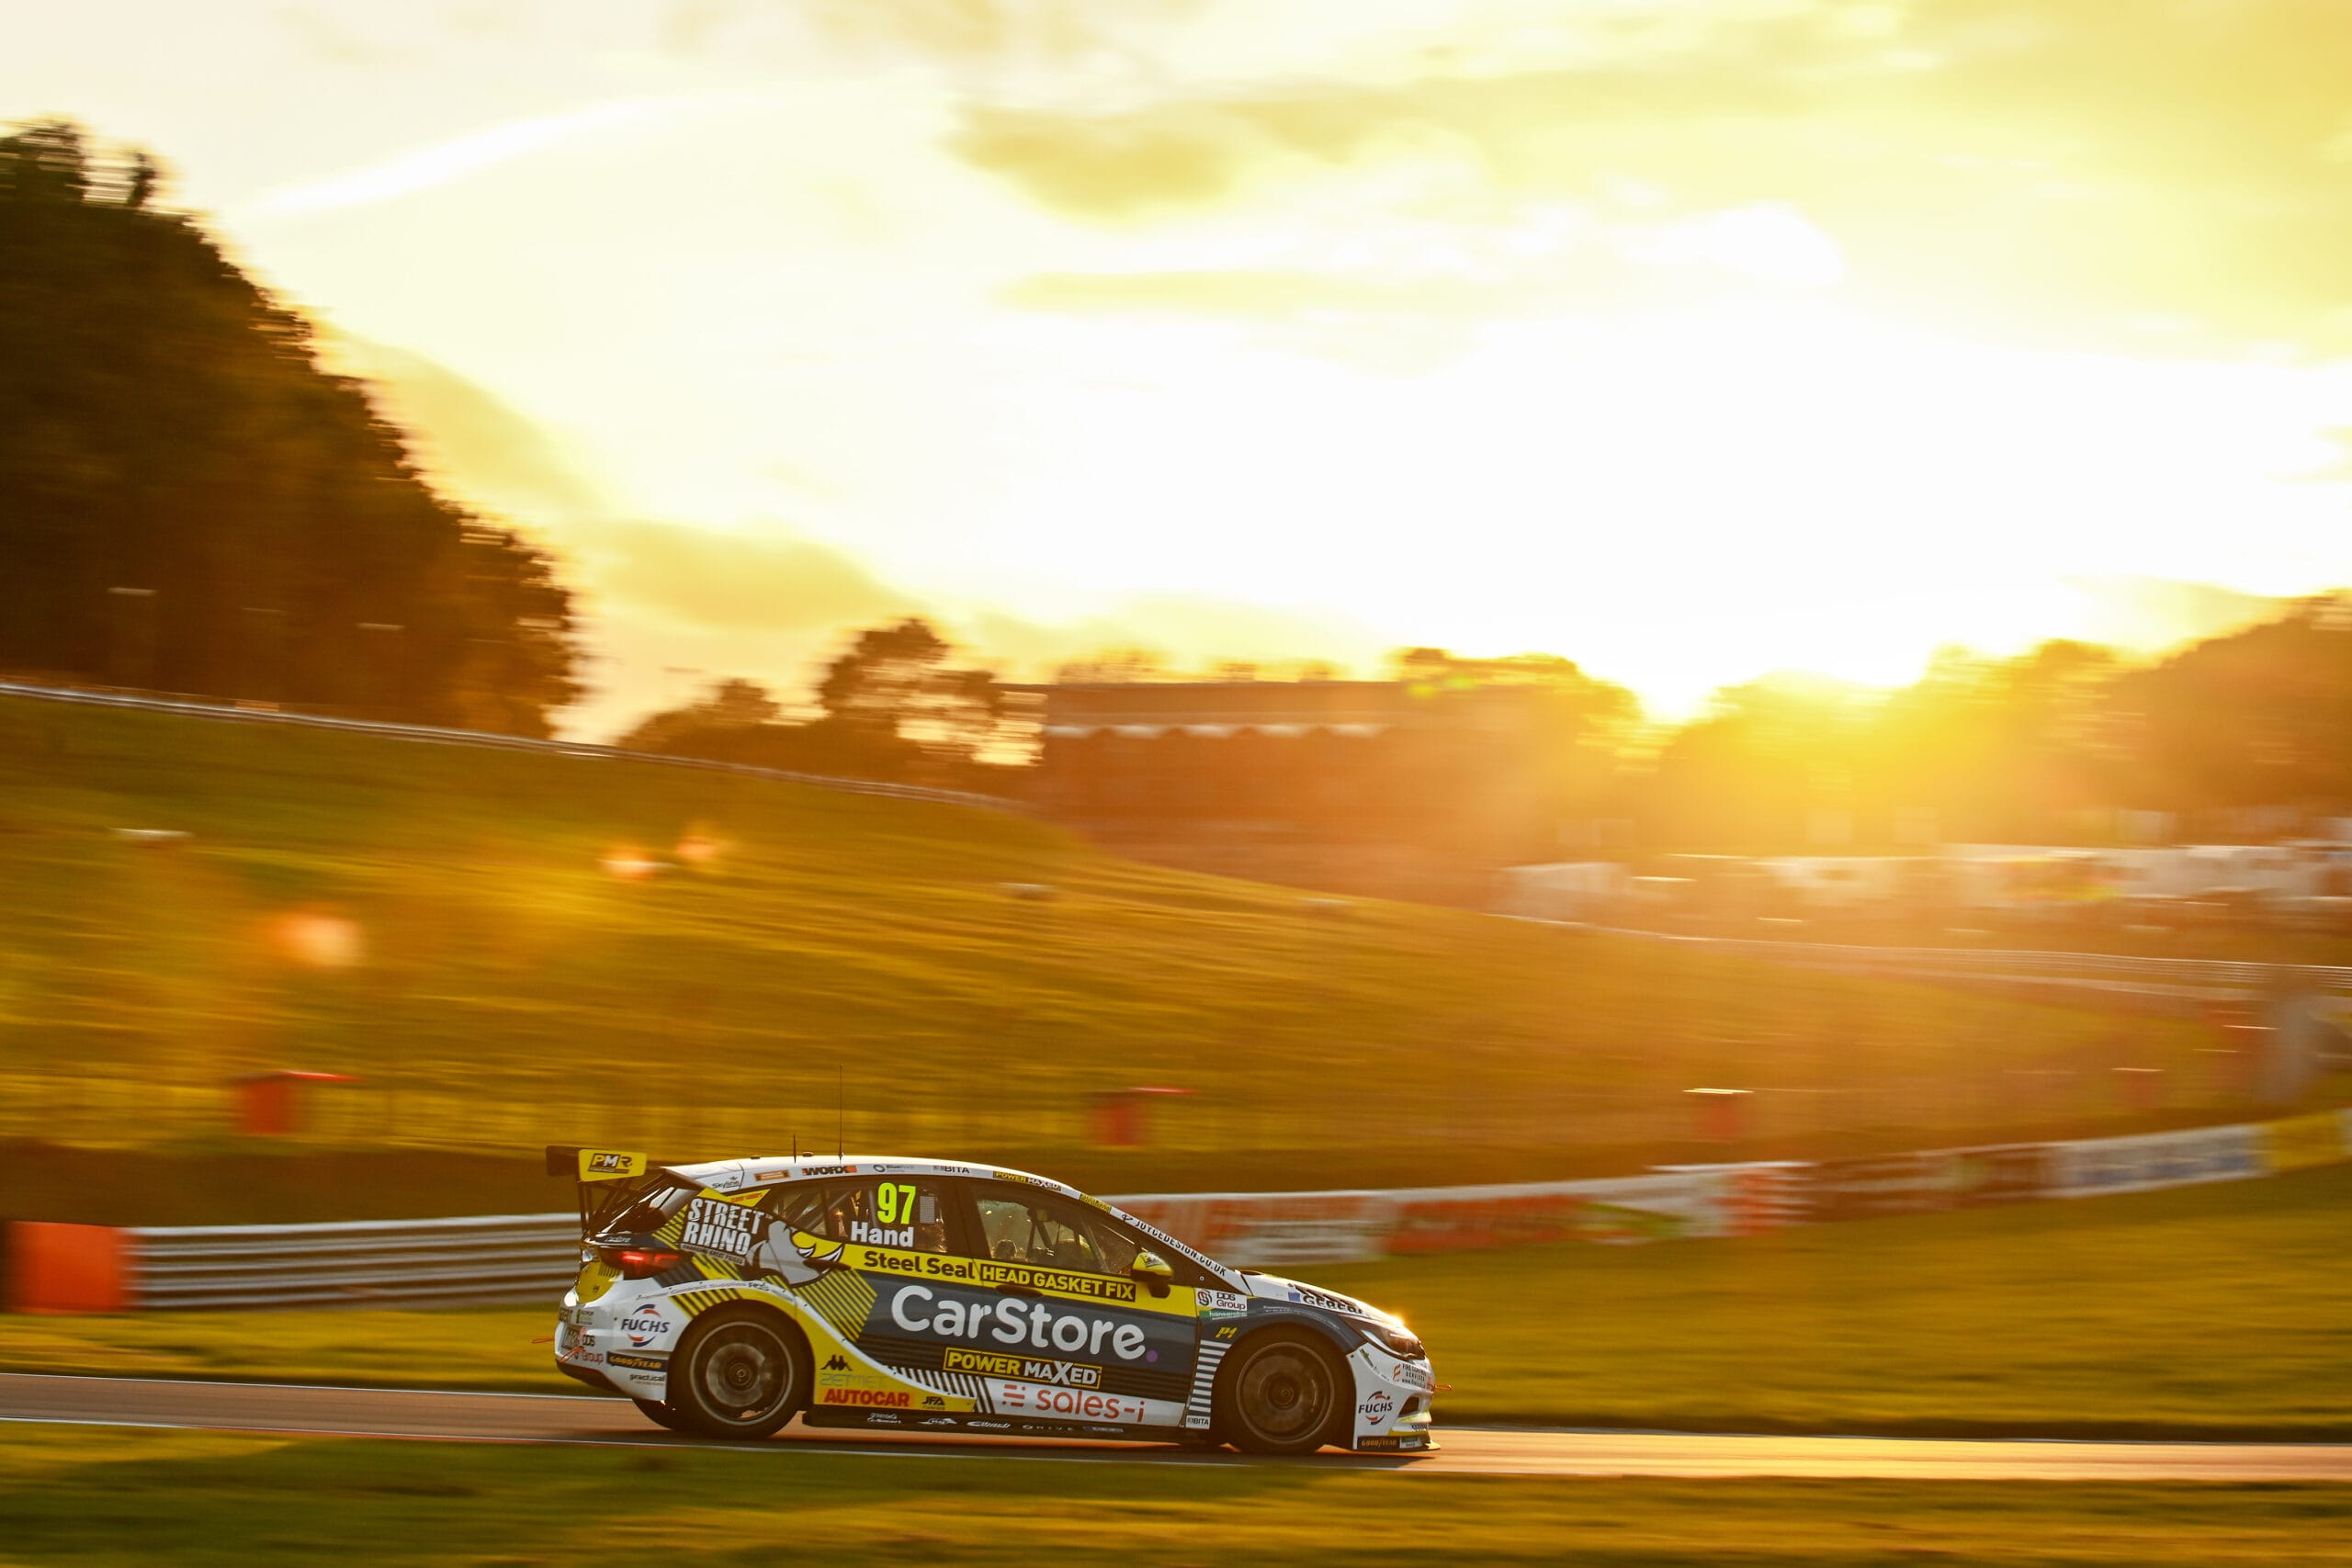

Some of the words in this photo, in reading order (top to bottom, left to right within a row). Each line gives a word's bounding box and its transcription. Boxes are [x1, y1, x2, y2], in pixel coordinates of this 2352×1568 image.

[592, 1154, 632, 1168] PMR
[687, 1197, 765, 1235] STREET
[876, 1181, 917, 1225] 97
[683, 1220, 752, 1256] RHINO
[850, 1220, 914, 1248] Hand
[864, 1250, 922, 1273] Steel
[926, 1258, 976, 1280] Seal
[982, 1266, 1031, 1285] HEAD
[1033, 1273, 1102, 1295] GASKET
[1105, 1283, 1134, 1301] FIX
[1216, 1292, 1237, 1302] DDS
[1216, 1299, 1247, 1311] Group
[620, 1318, 671, 1334] FUCHS
[947, 1351, 1021, 1376] POWER
[1023, 1360, 1098, 1386] MAXED
[823, 1388, 911, 1407] AUTOCAR
[1035, 1388, 1146, 1423] sales-i
[1358, 1401, 1394, 1415] FUCHS
